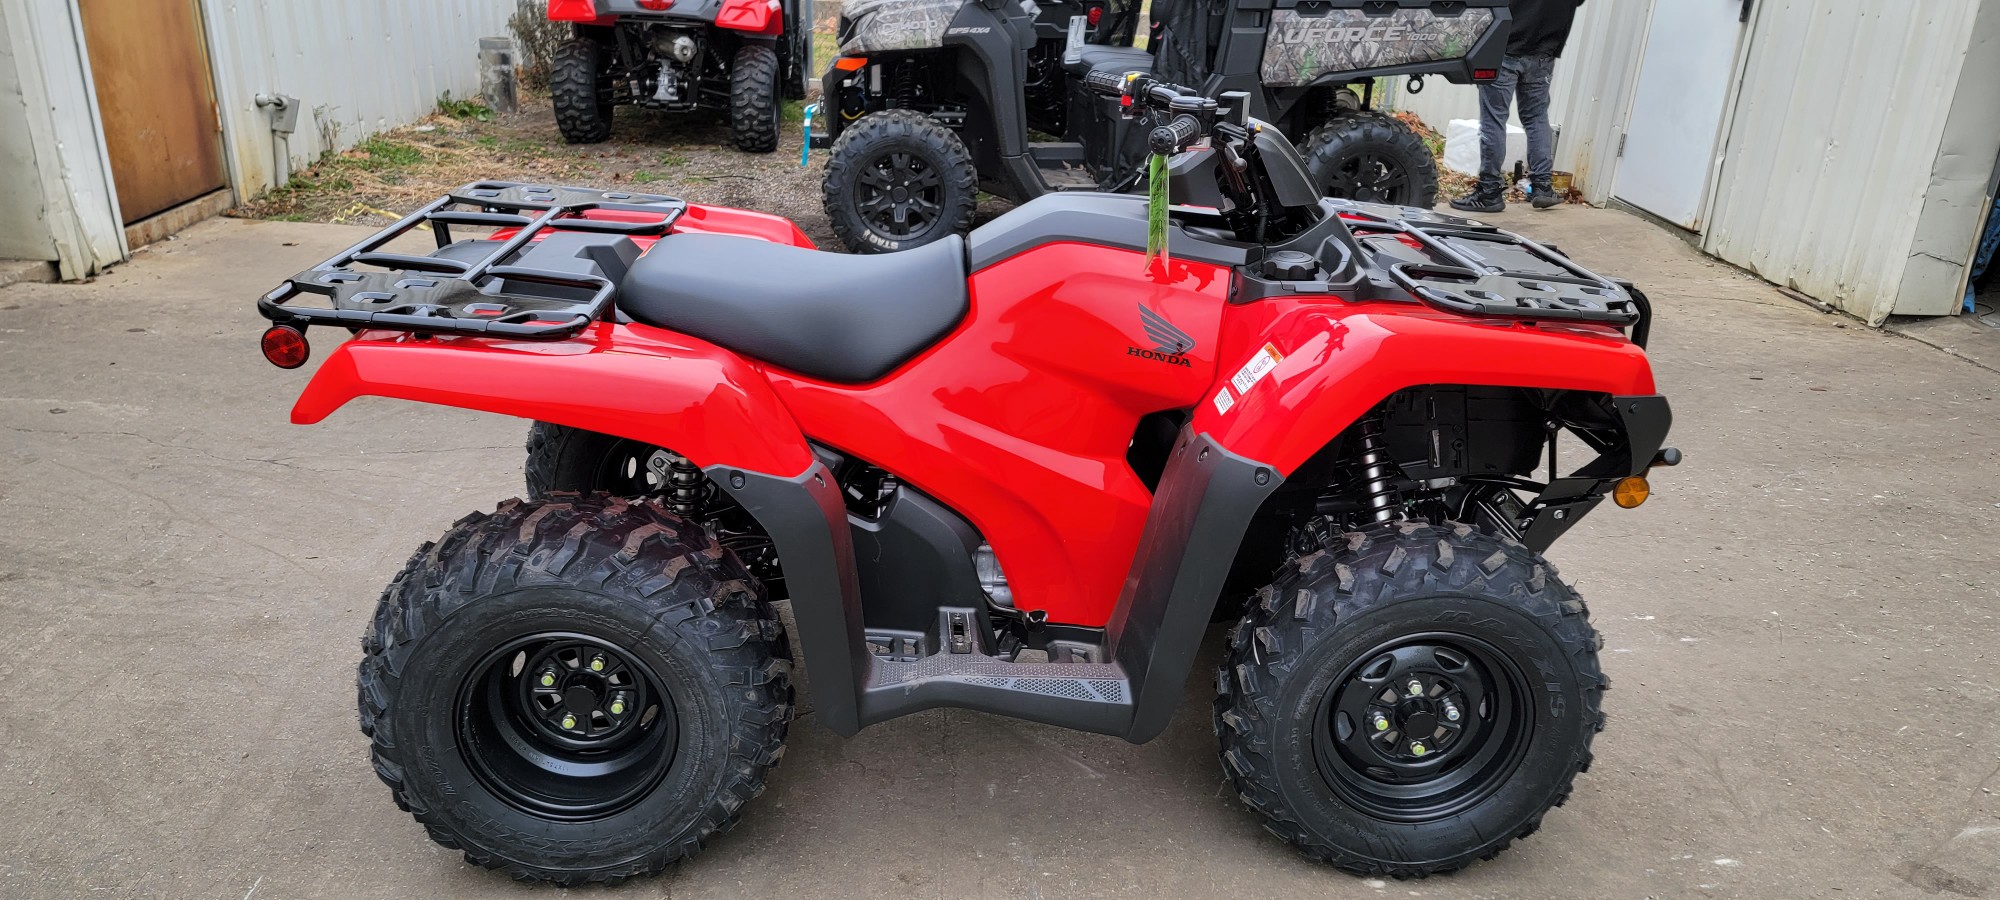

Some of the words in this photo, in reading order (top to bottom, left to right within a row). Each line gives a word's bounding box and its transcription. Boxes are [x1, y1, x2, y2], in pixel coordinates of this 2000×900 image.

[1284, 26, 1406, 44] UFORCE
[1406, 33, 1437, 41] 1000
[1126, 346, 1192, 368] HONDA
